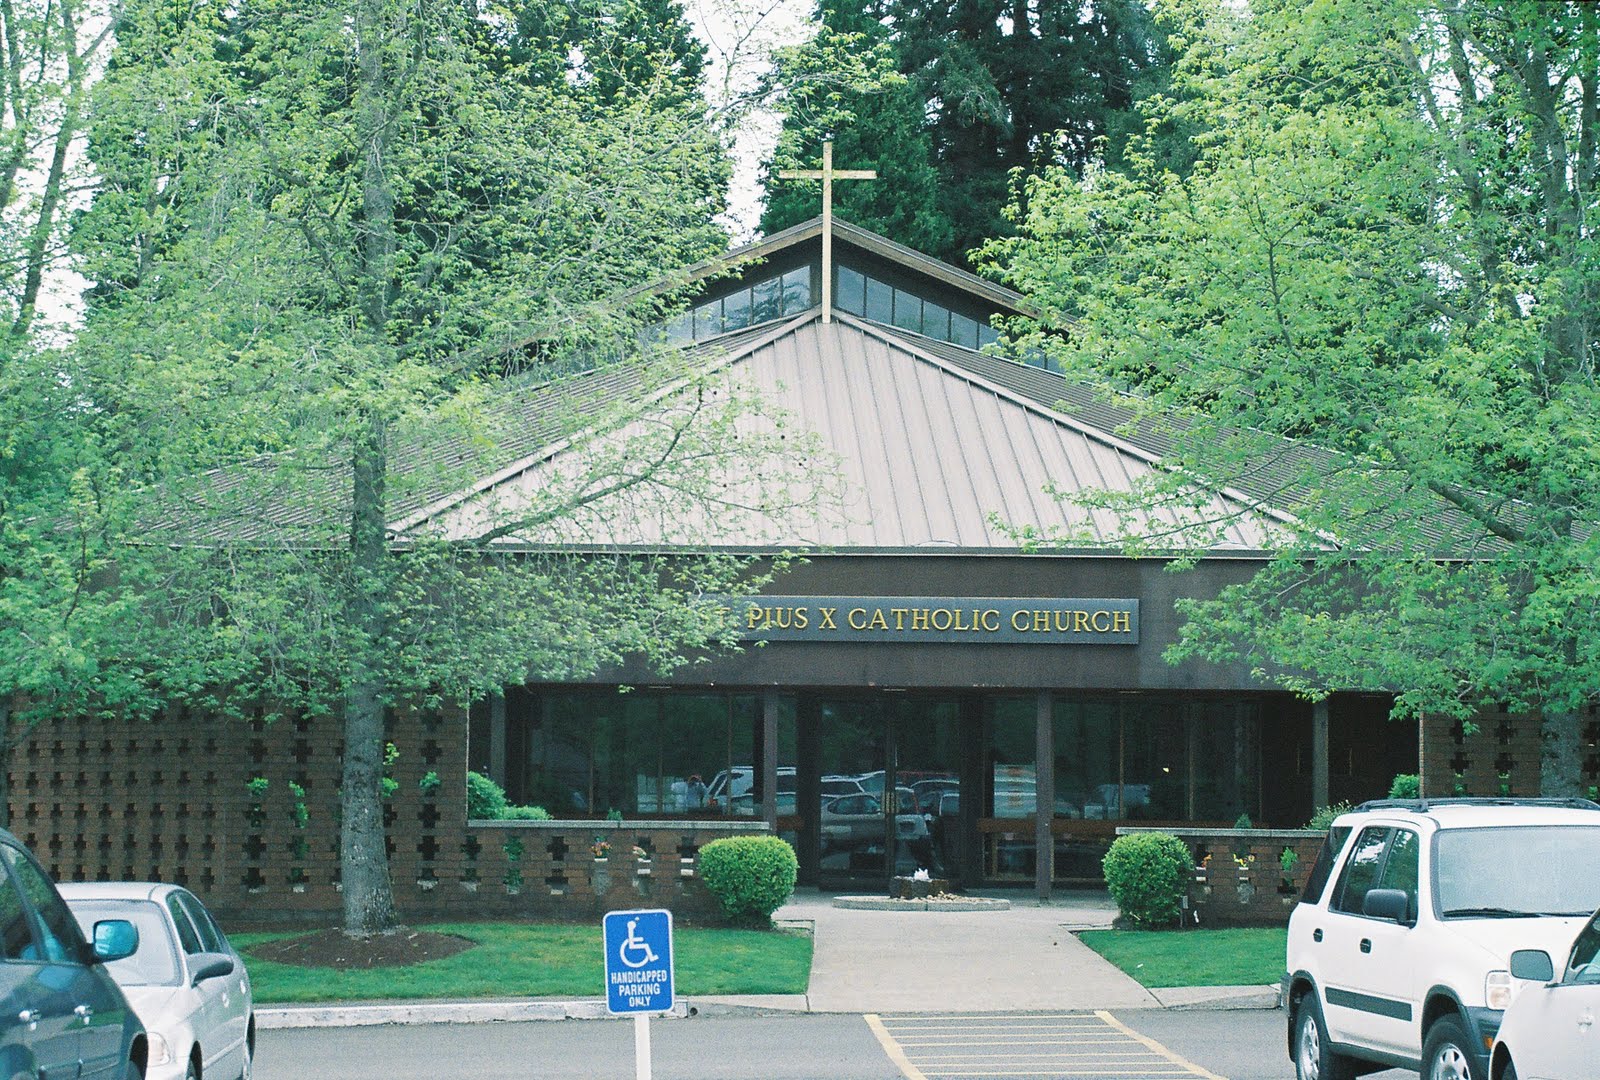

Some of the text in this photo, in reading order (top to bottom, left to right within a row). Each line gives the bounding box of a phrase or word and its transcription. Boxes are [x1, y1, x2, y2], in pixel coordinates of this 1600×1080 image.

[747, 607, 809, 629] PIUS
[818, 607, 837, 629] X
[848, 607, 1000, 631] CATHOLIC
[1011, 609, 1131, 632] CHURCH
[611, 970, 667, 984] HANDICAPPED
[619, 983, 661, 996] PARKING
[629, 996, 651, 1007] ONLY
